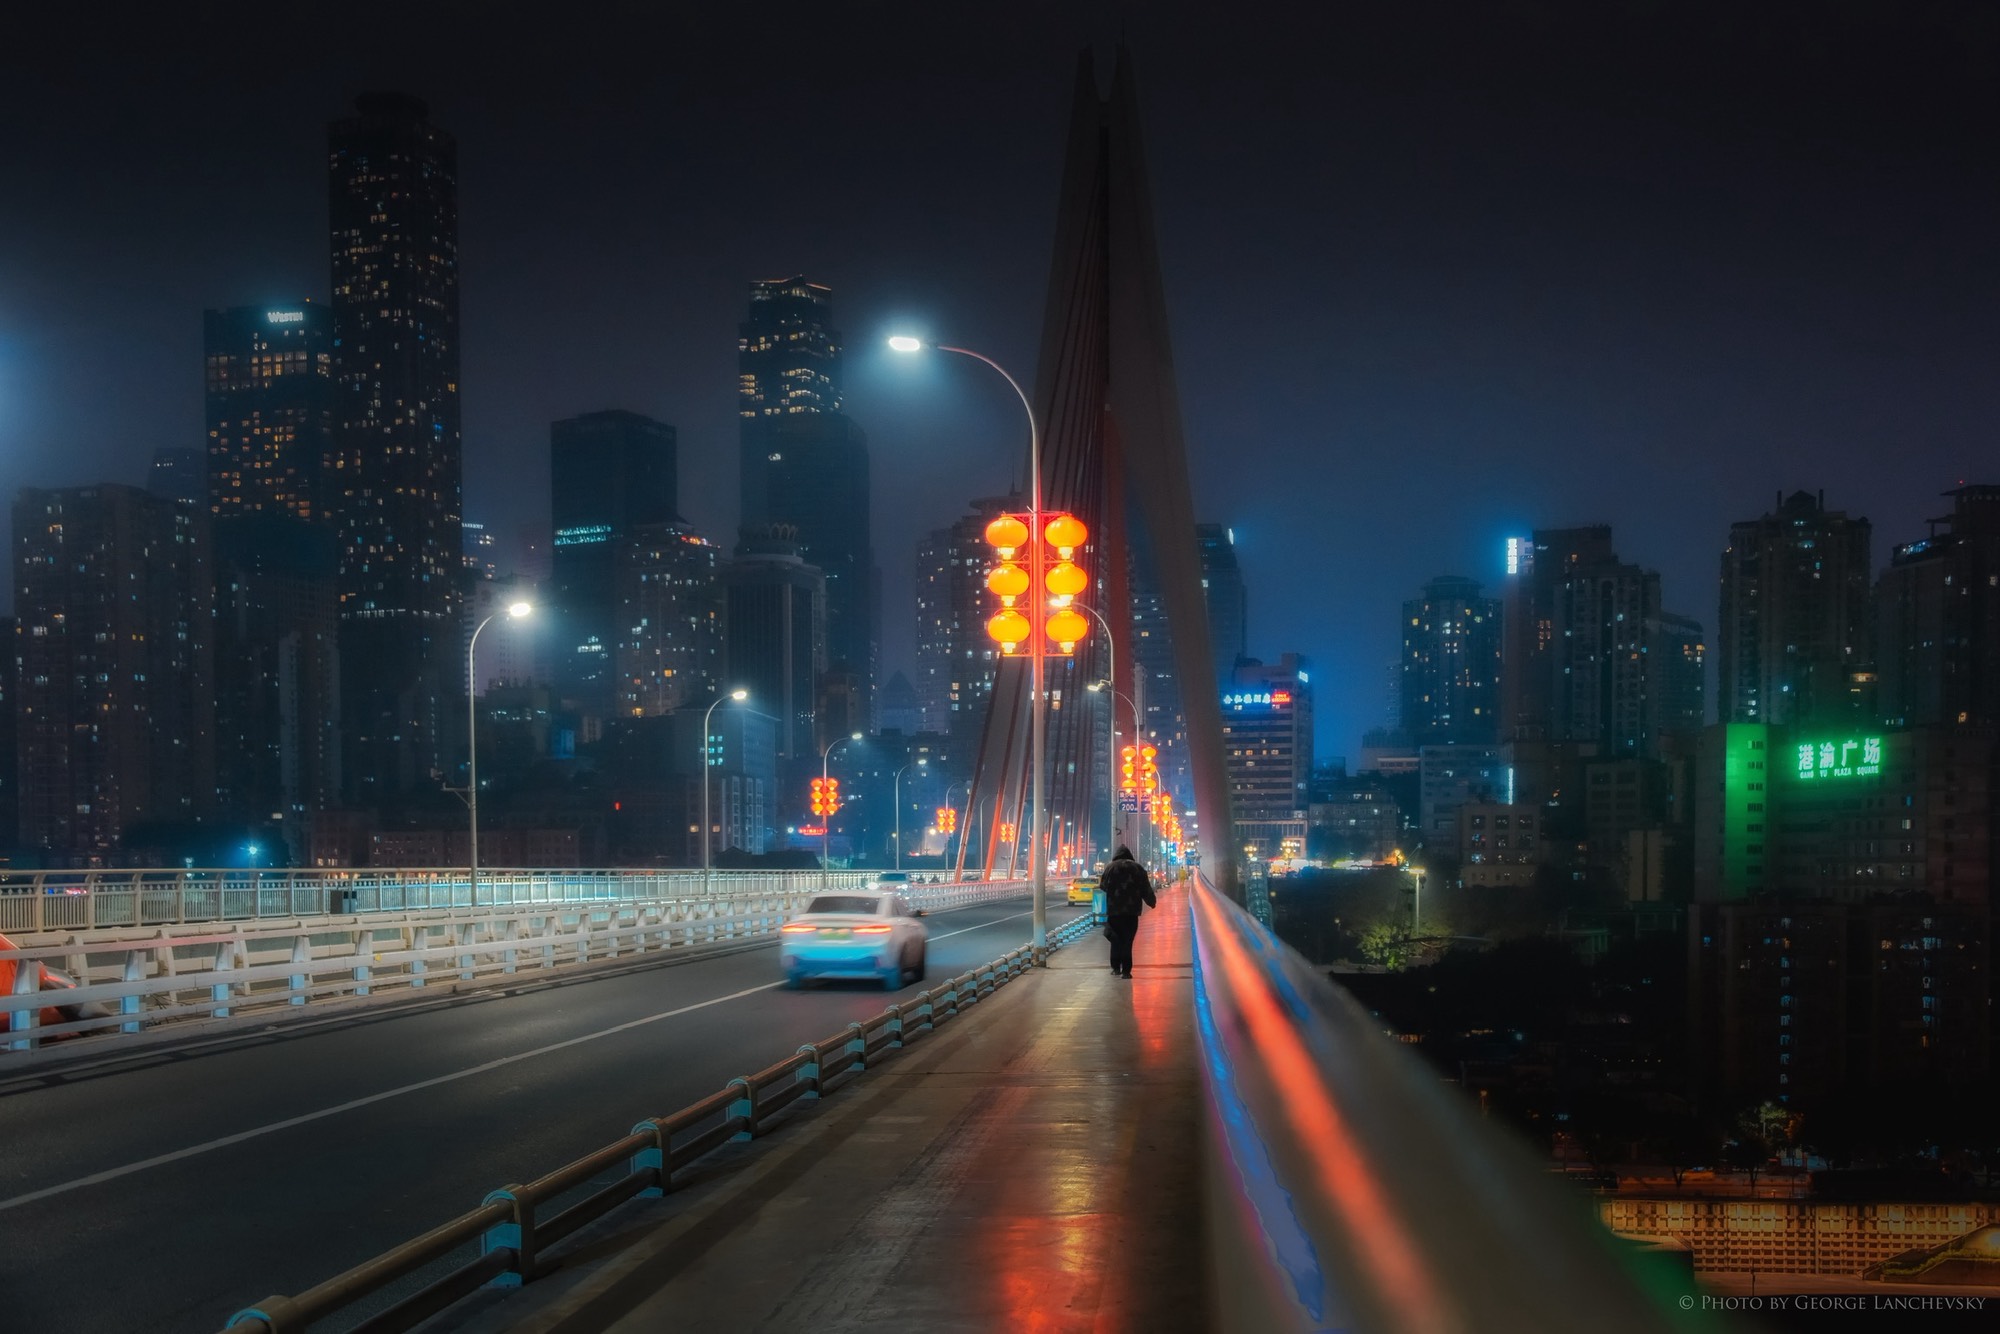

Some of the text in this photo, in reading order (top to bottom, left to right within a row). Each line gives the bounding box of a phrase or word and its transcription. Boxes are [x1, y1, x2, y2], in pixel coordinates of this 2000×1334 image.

[1798, 738, 1880, 770] 港渝广场
[1834, 768, 1852, 776] PLAZA
[1857, 765, 1879, 776] SQUARE
